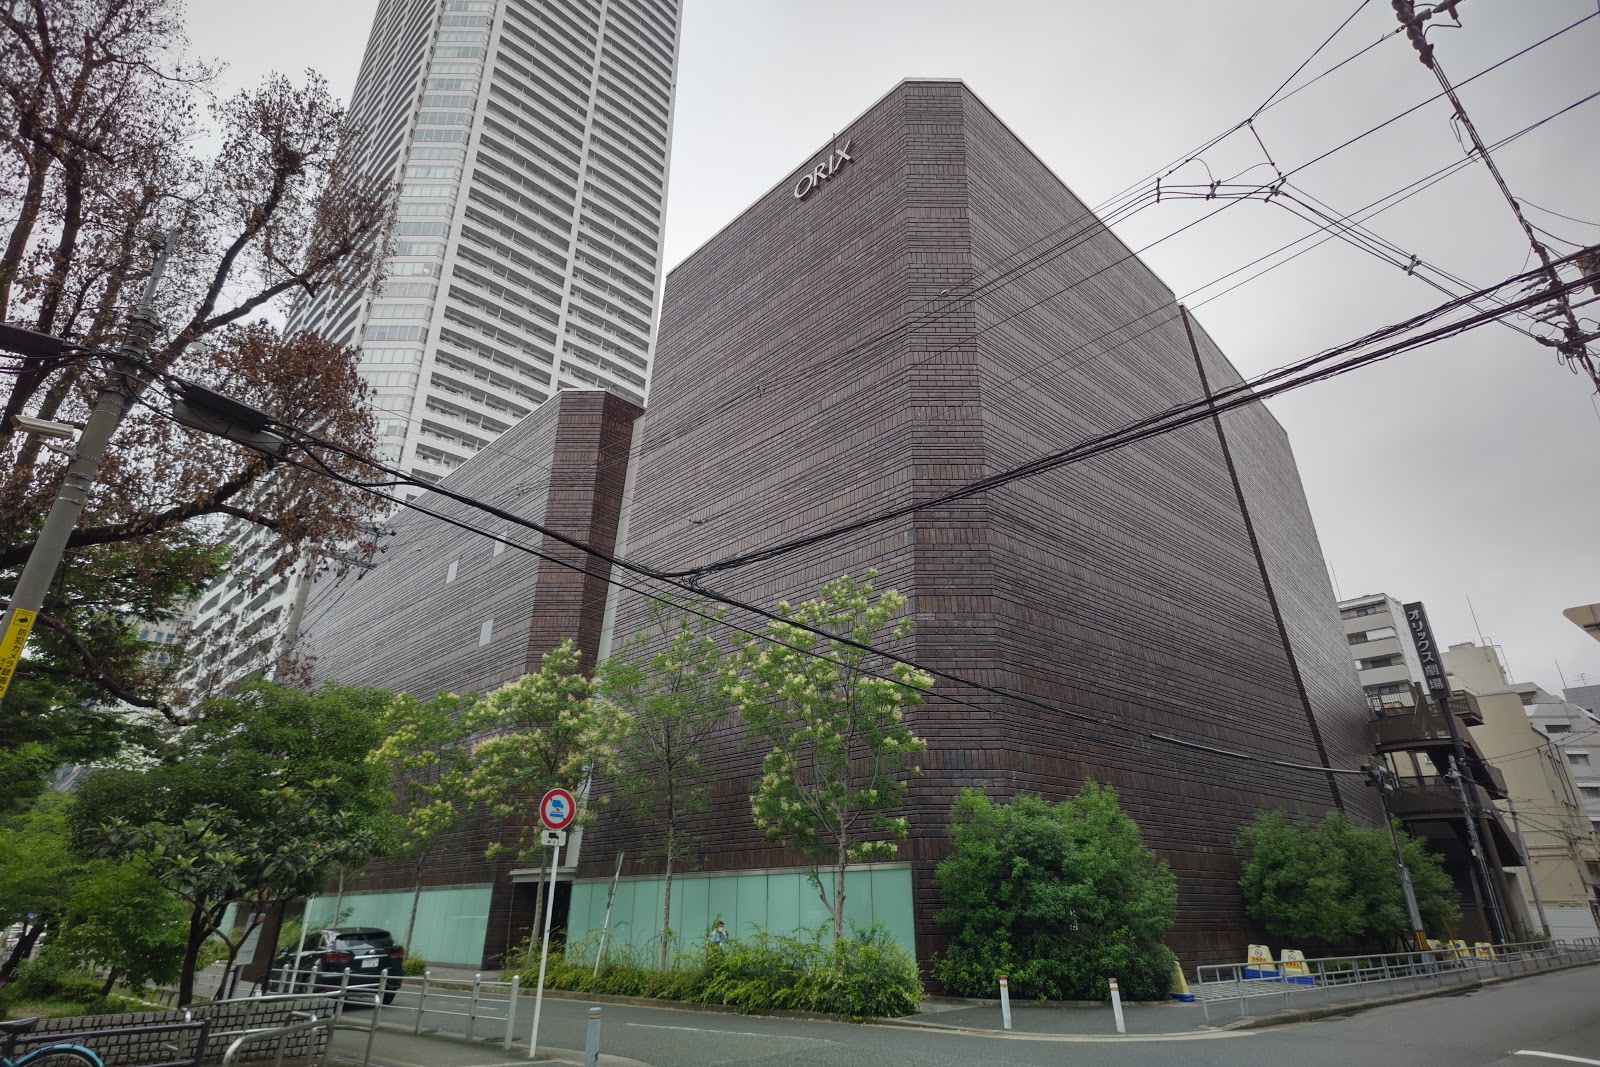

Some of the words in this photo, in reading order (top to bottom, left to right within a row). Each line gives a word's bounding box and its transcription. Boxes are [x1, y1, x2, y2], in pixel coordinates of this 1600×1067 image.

[794, 138, 852, 199] ORIX
[1408, 609, 1444, 690] オリックス劇場
